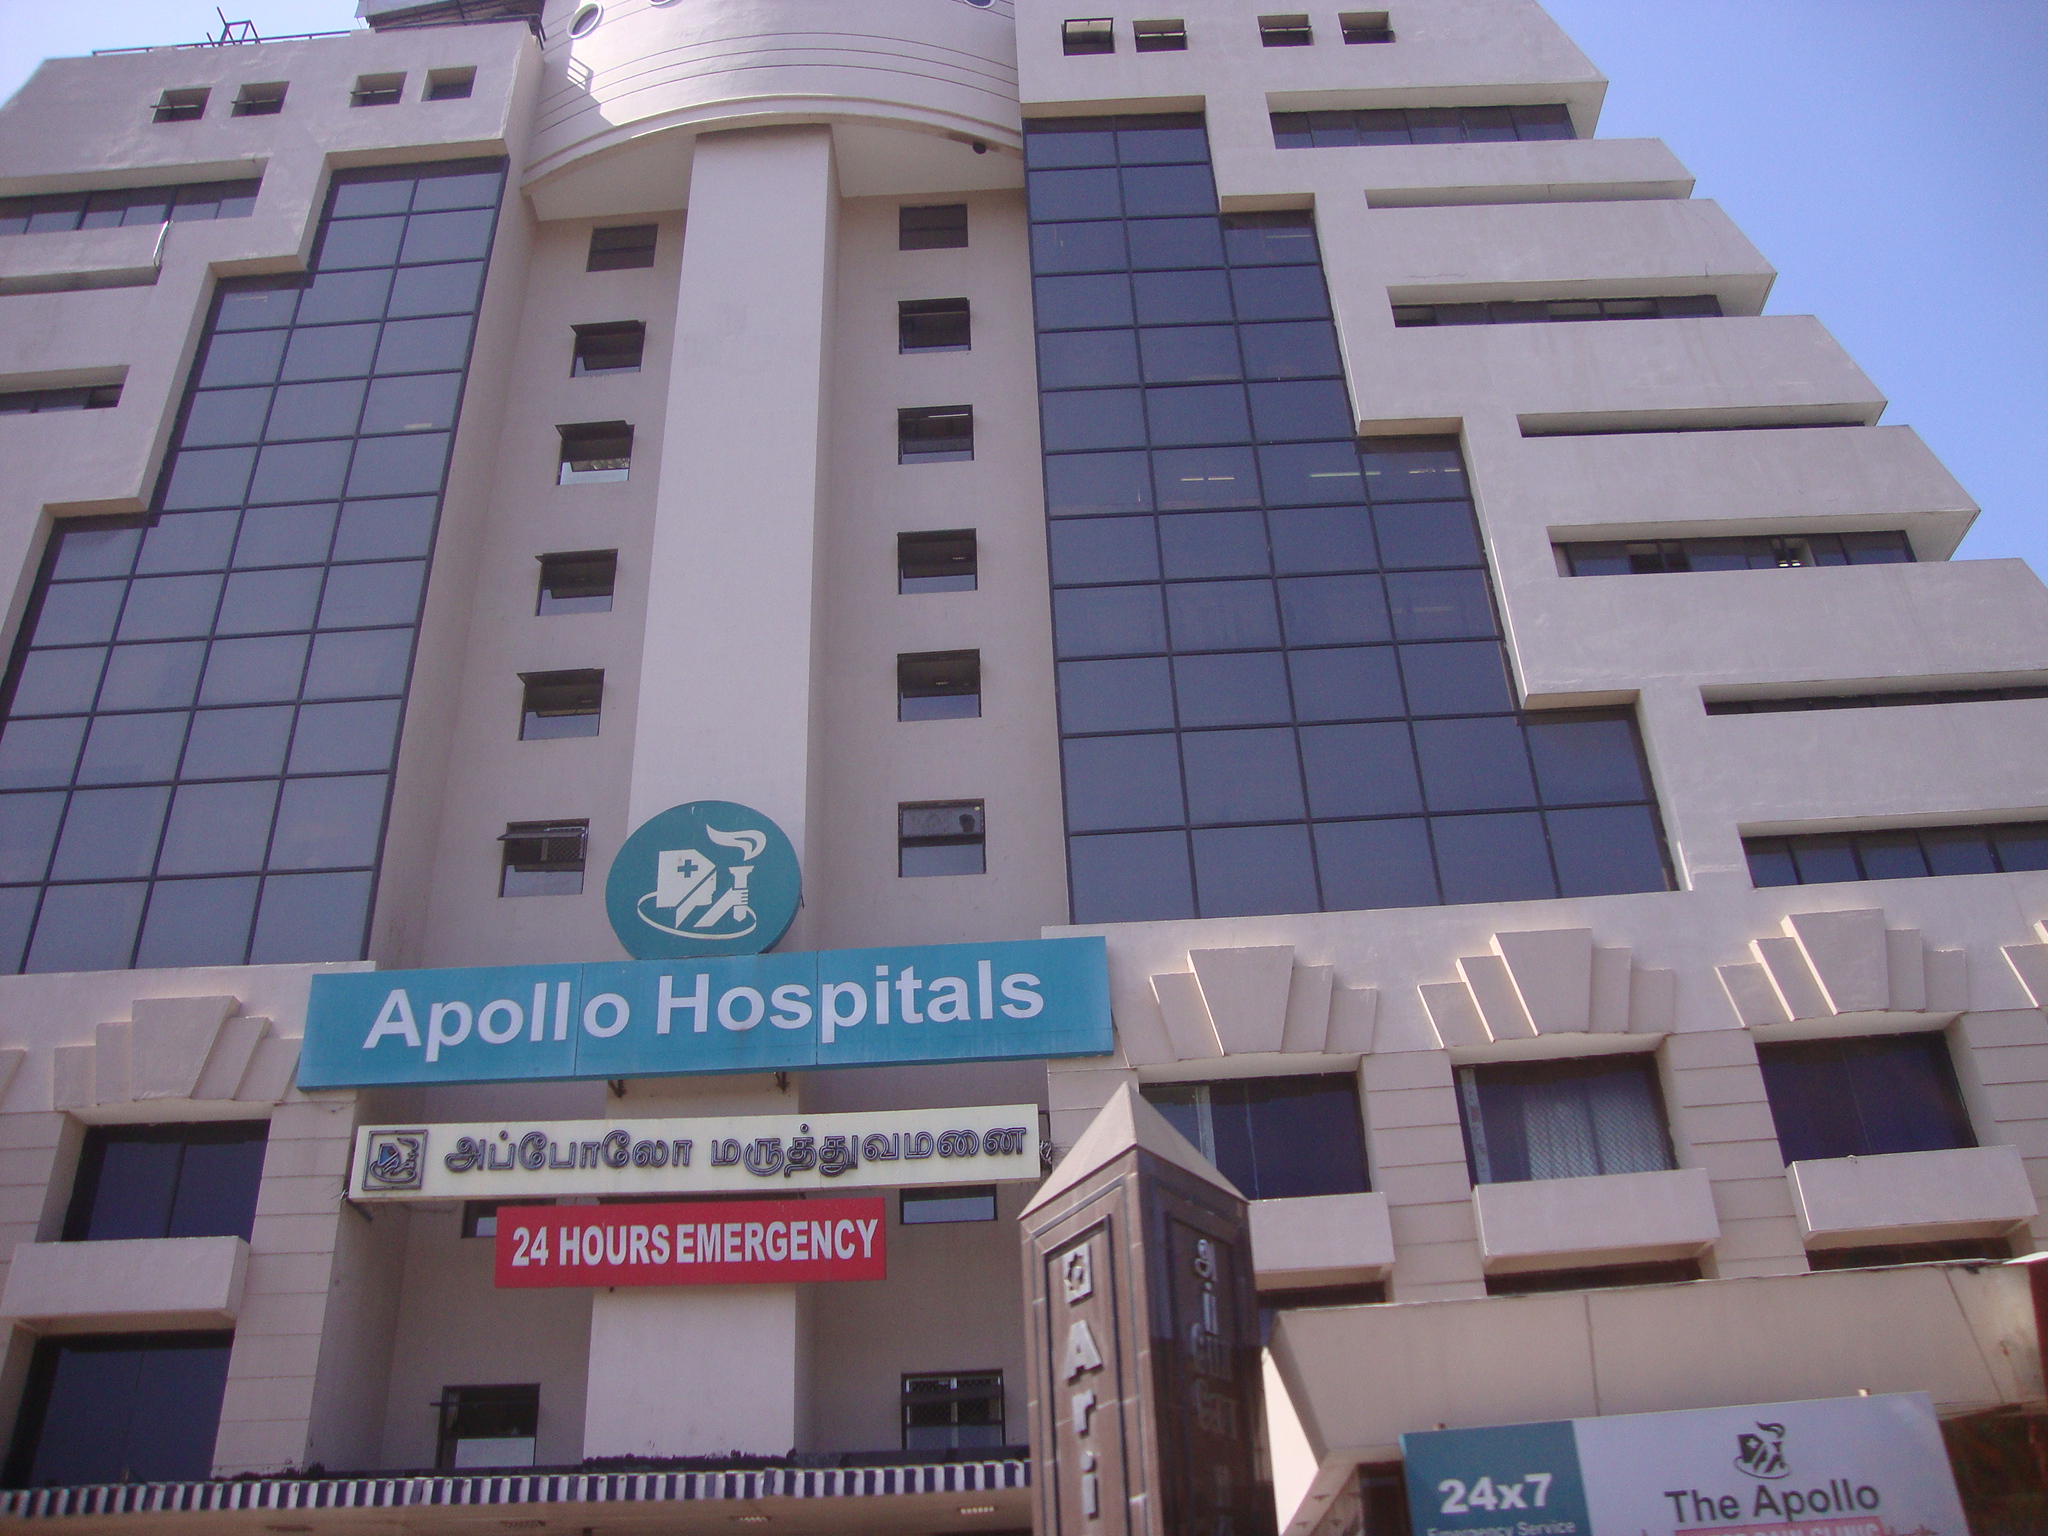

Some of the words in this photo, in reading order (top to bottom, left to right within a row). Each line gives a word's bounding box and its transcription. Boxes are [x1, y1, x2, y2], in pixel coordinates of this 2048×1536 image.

[362, 981, 631, 1063] Apollo
[656, 959, 1045, 1043] Hospitals
[443, 1129, 693, 1173] அப்போலோ
[711, 1123, 1028, 1178] மருத்துவமனை
[511, 1226, 549, 1267] 24
[559, 1224, 671, 1266] HOURS
[676, 1218, 879, 1264] EMERGENCY
[1437, 1472, 1552, 1514] 24x7
[1663, 1489, 1740, 1524] The
[1753, 1478, 1881, 1523] Apollo
[1517, 1520, 1577, 1536] Service
